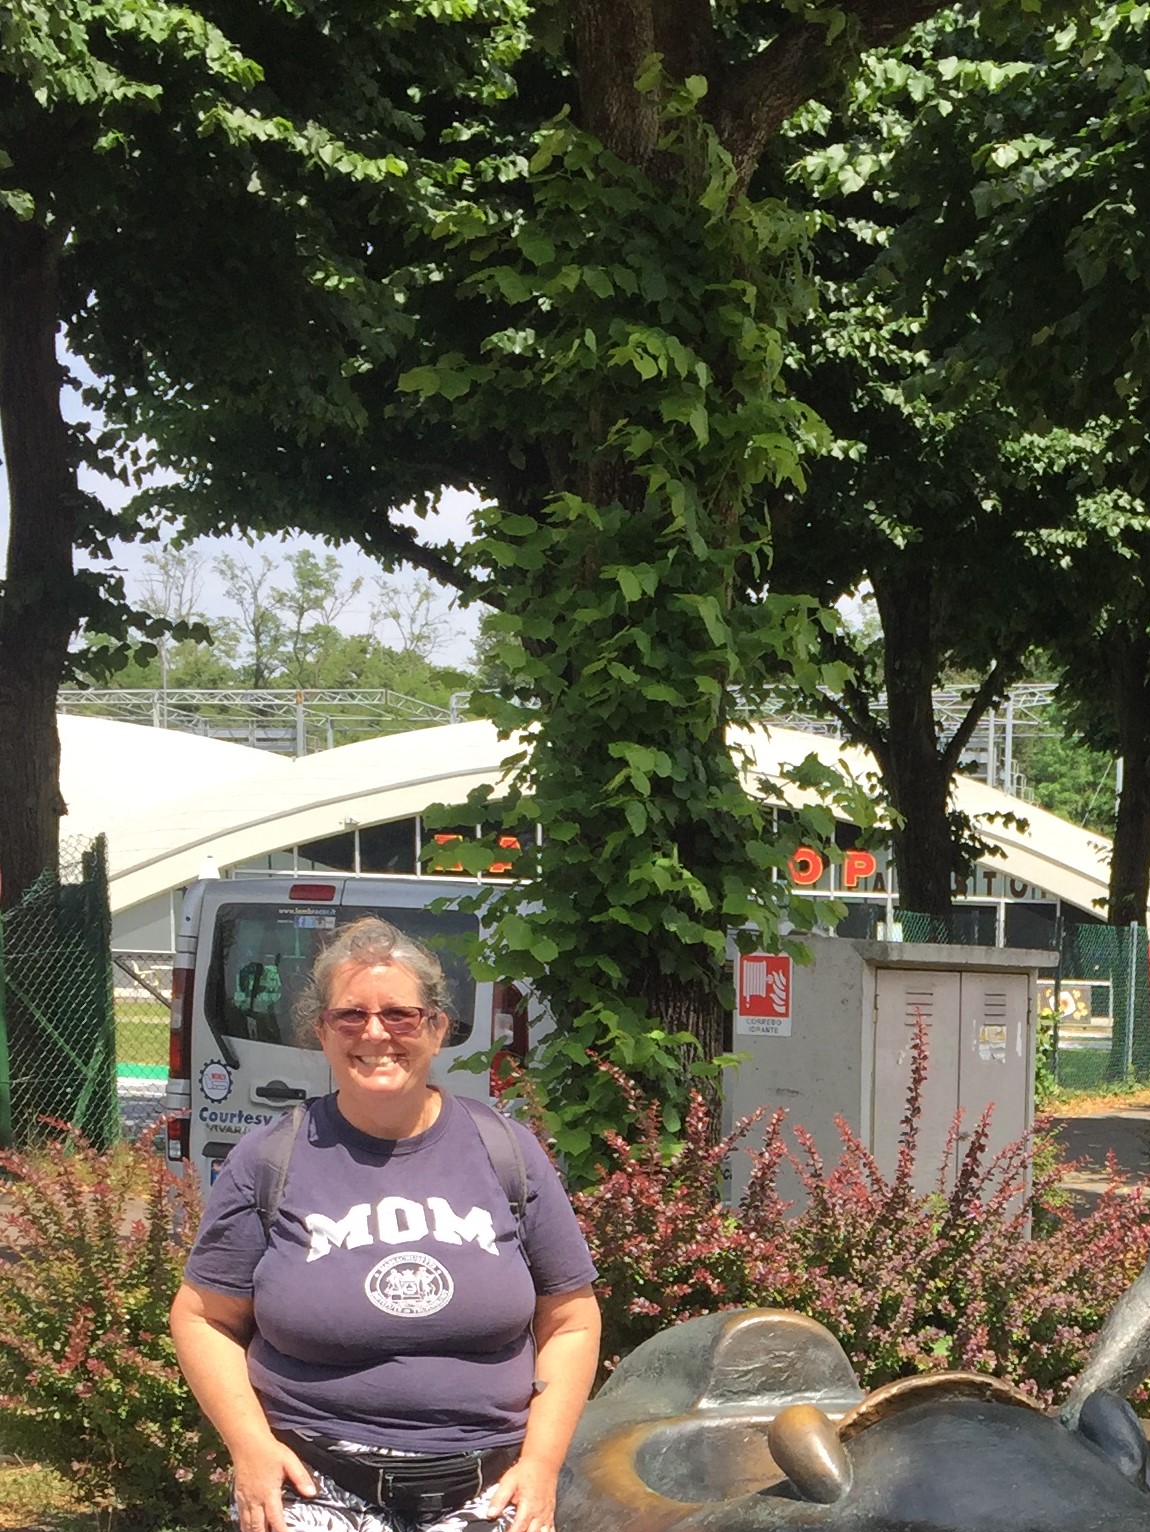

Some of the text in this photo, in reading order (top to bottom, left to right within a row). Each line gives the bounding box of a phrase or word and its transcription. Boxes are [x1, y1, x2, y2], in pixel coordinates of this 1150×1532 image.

[748, 1025, 779, 1034] IDRANTE
[199, 1106, 273, 1126] Courtesy
[305, 1196, 500, 1263] MOM
